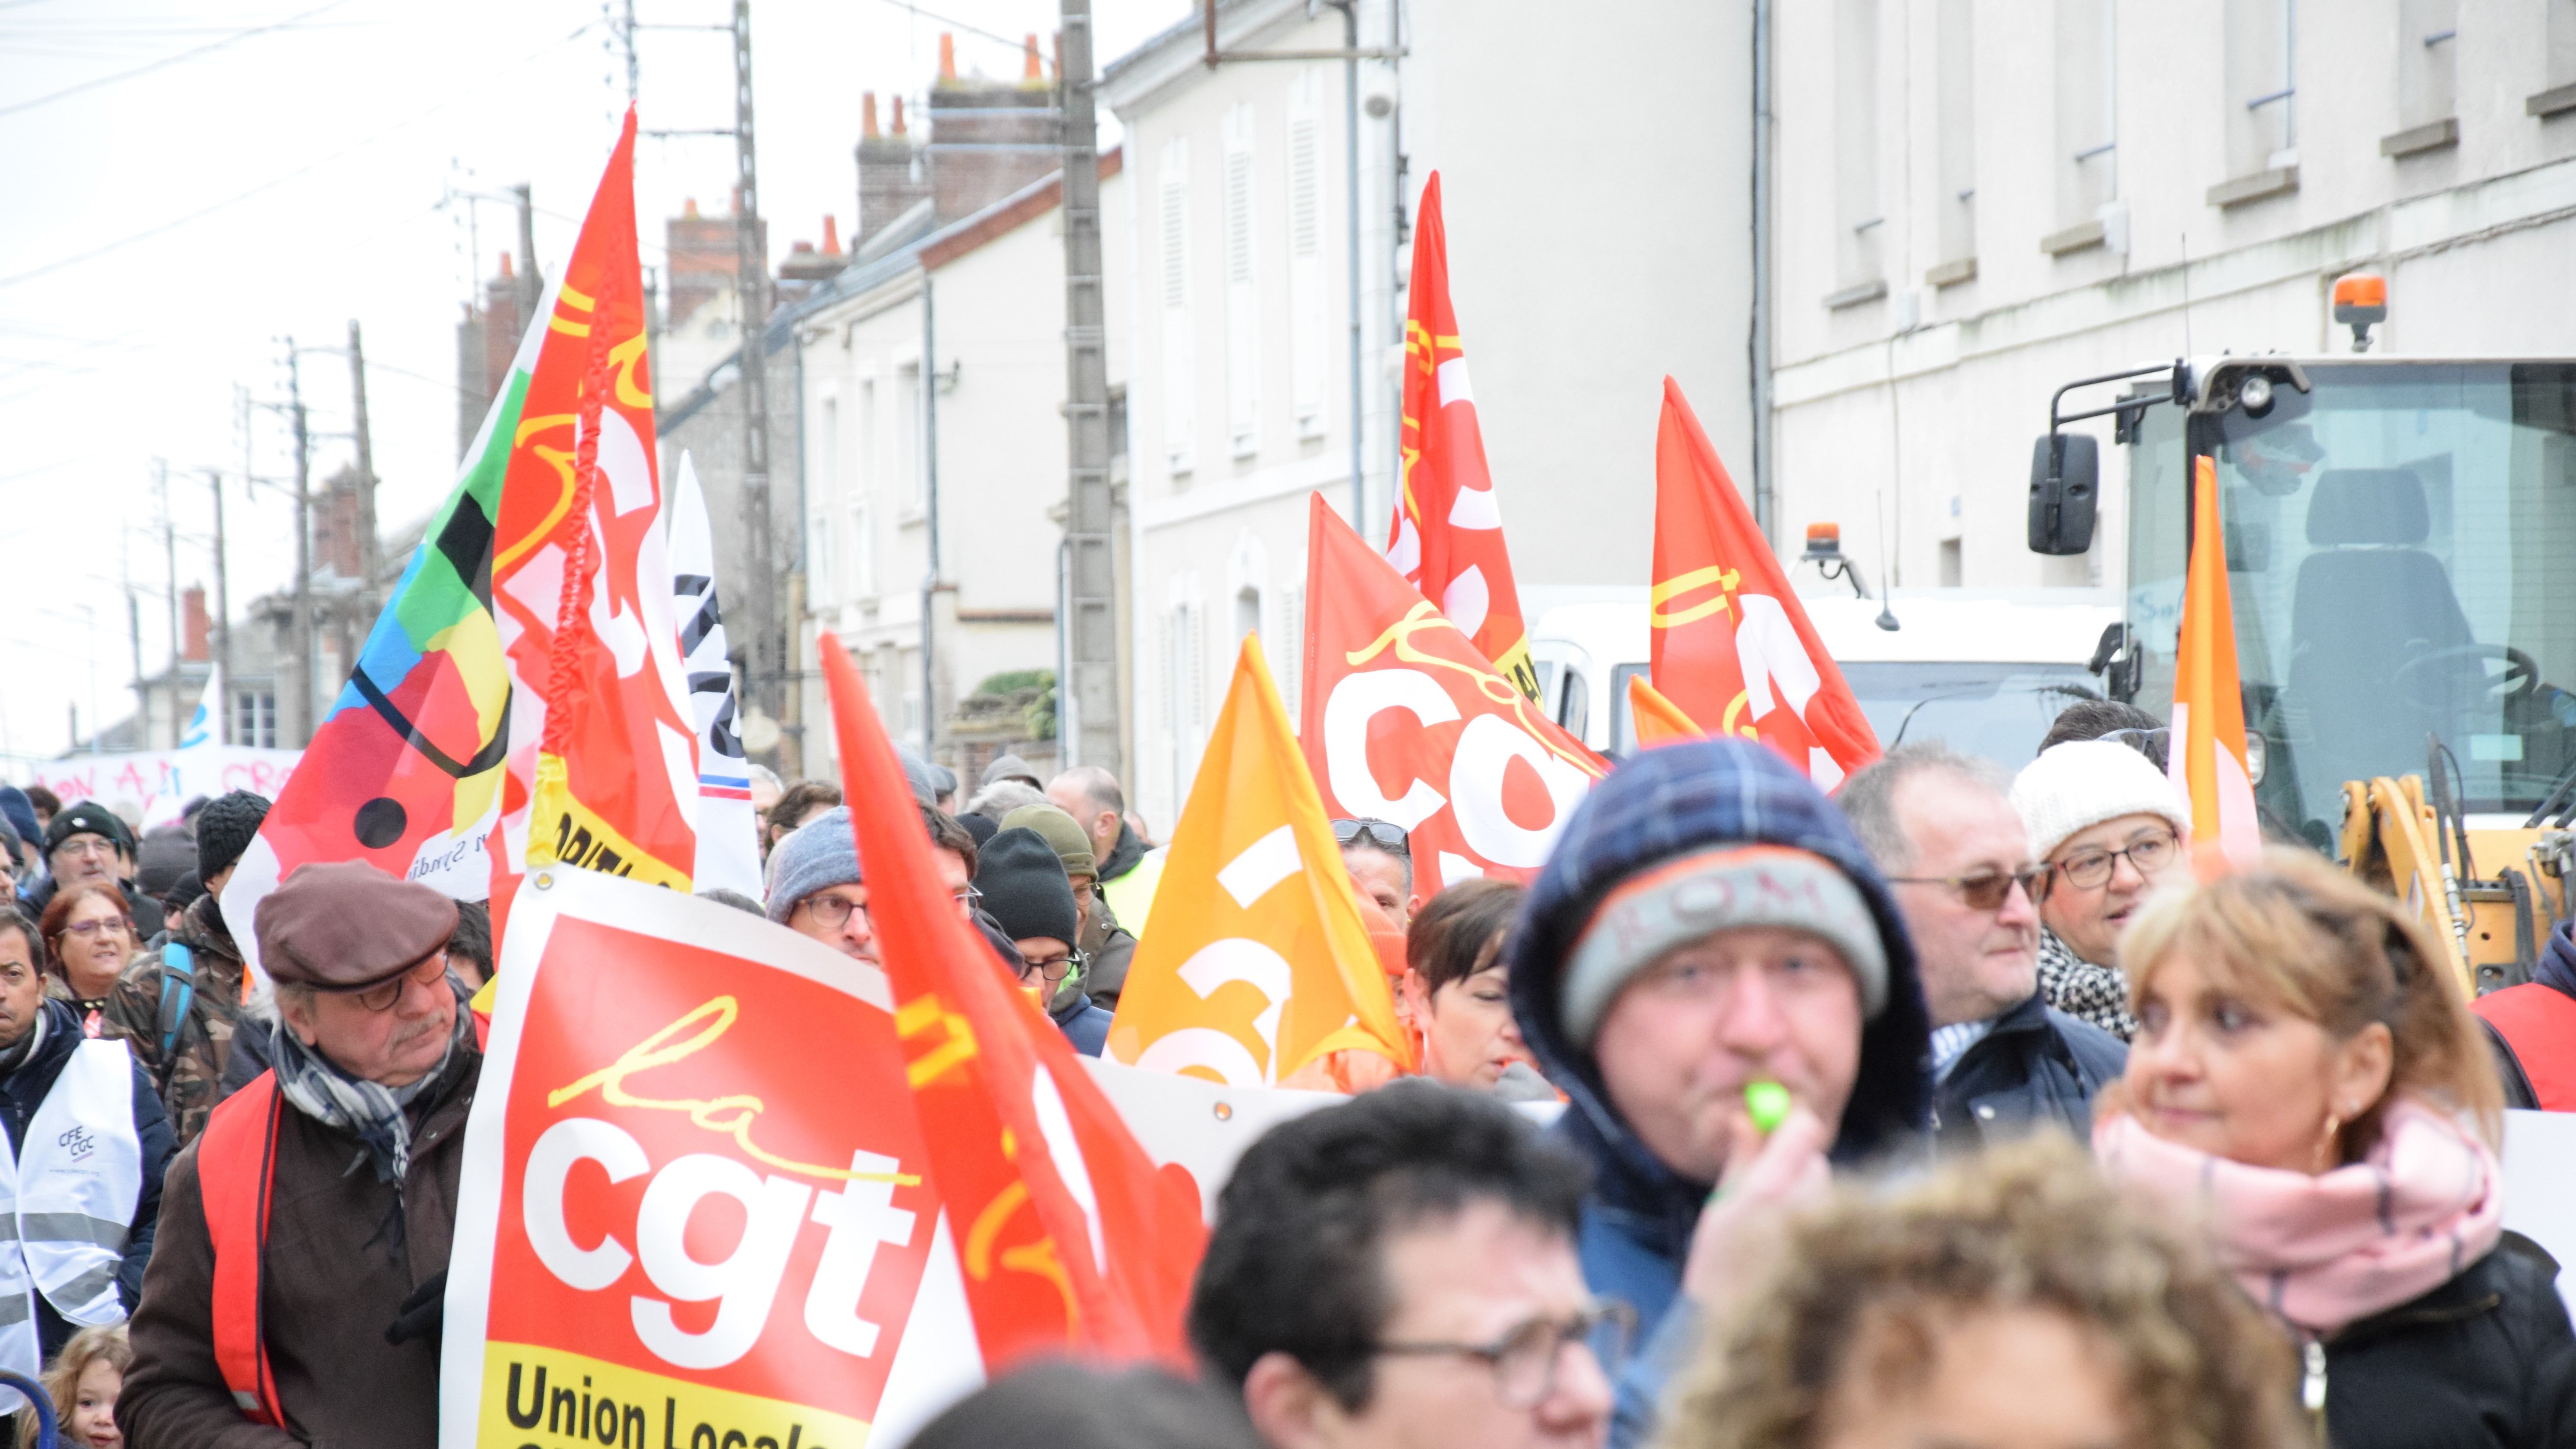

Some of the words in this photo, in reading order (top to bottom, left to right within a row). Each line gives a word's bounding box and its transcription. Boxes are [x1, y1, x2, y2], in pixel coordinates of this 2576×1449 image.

[548, 995, 921, 1186] la
[59, 1126, 82, 1147] CFE
[70, 1135, 94, 1156] CGC
[522, 1117, 916, 1370] cgt
[506, 1362, 646, 1449] Union
[664, 1396, 826, 1449] Loc
